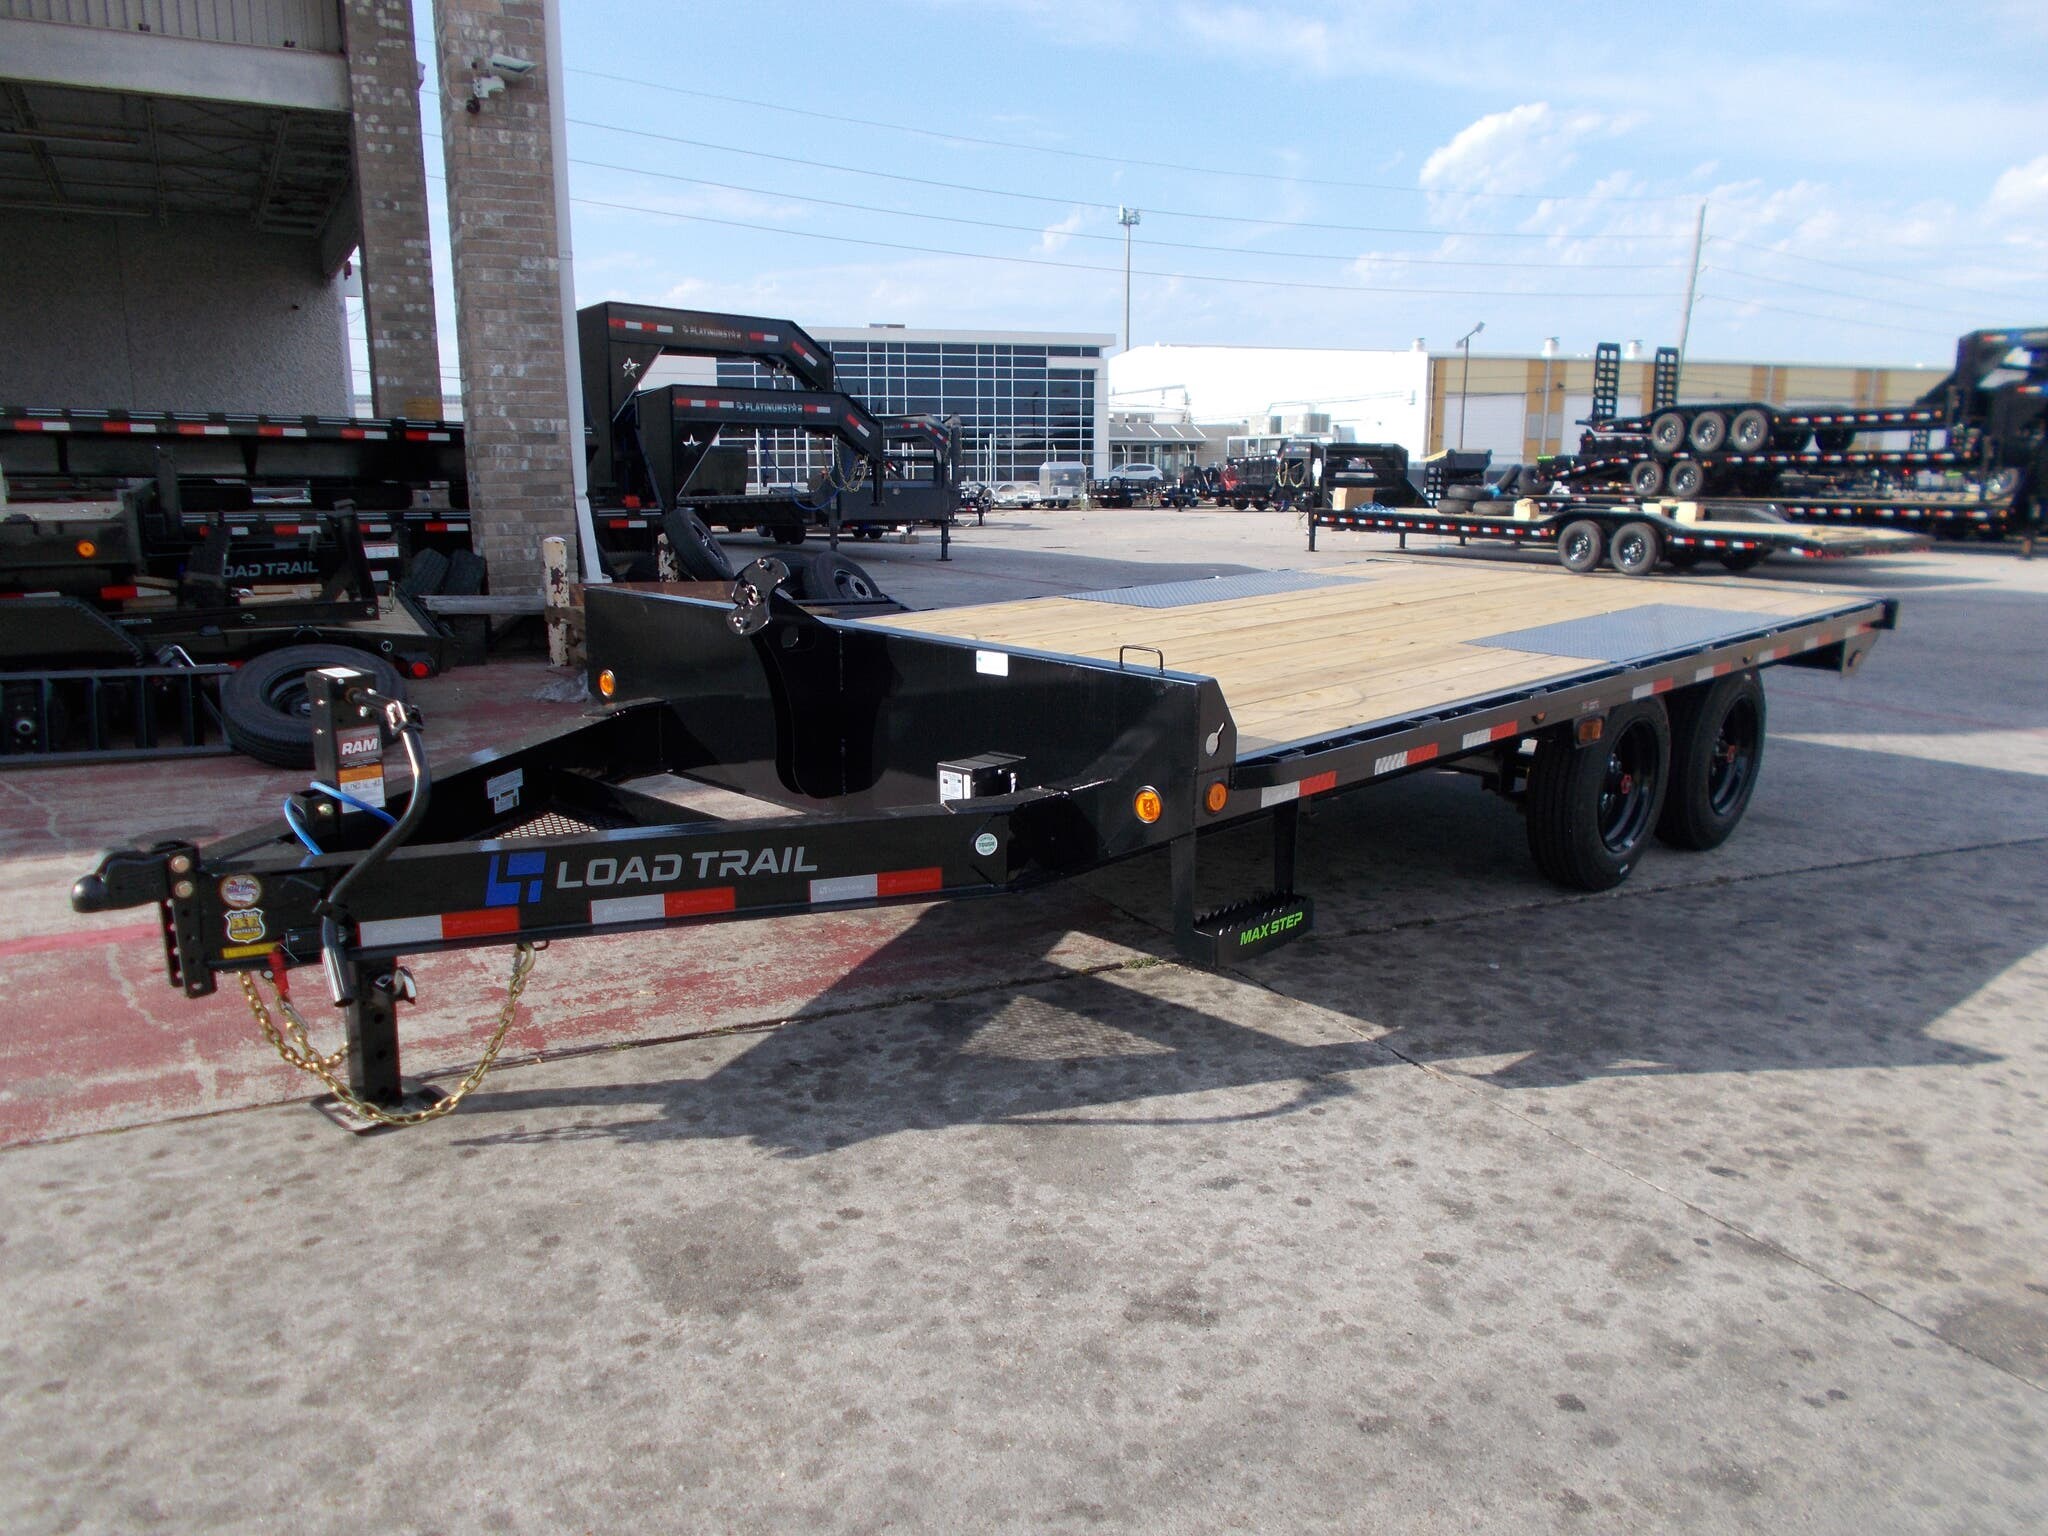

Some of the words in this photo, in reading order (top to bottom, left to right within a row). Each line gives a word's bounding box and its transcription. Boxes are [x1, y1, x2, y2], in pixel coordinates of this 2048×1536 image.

[222, 564, 262, 578] OAD
[265, 561, 320, 576] TRAIL
[341, 738, 378, 756] RAM
[556, 854, 683, 889] LOAD
[691, 846, 818, 879] TRAIL
[1240, 923, 1269, 945] MAX
[1270, 911, 1303, 934] STEP
